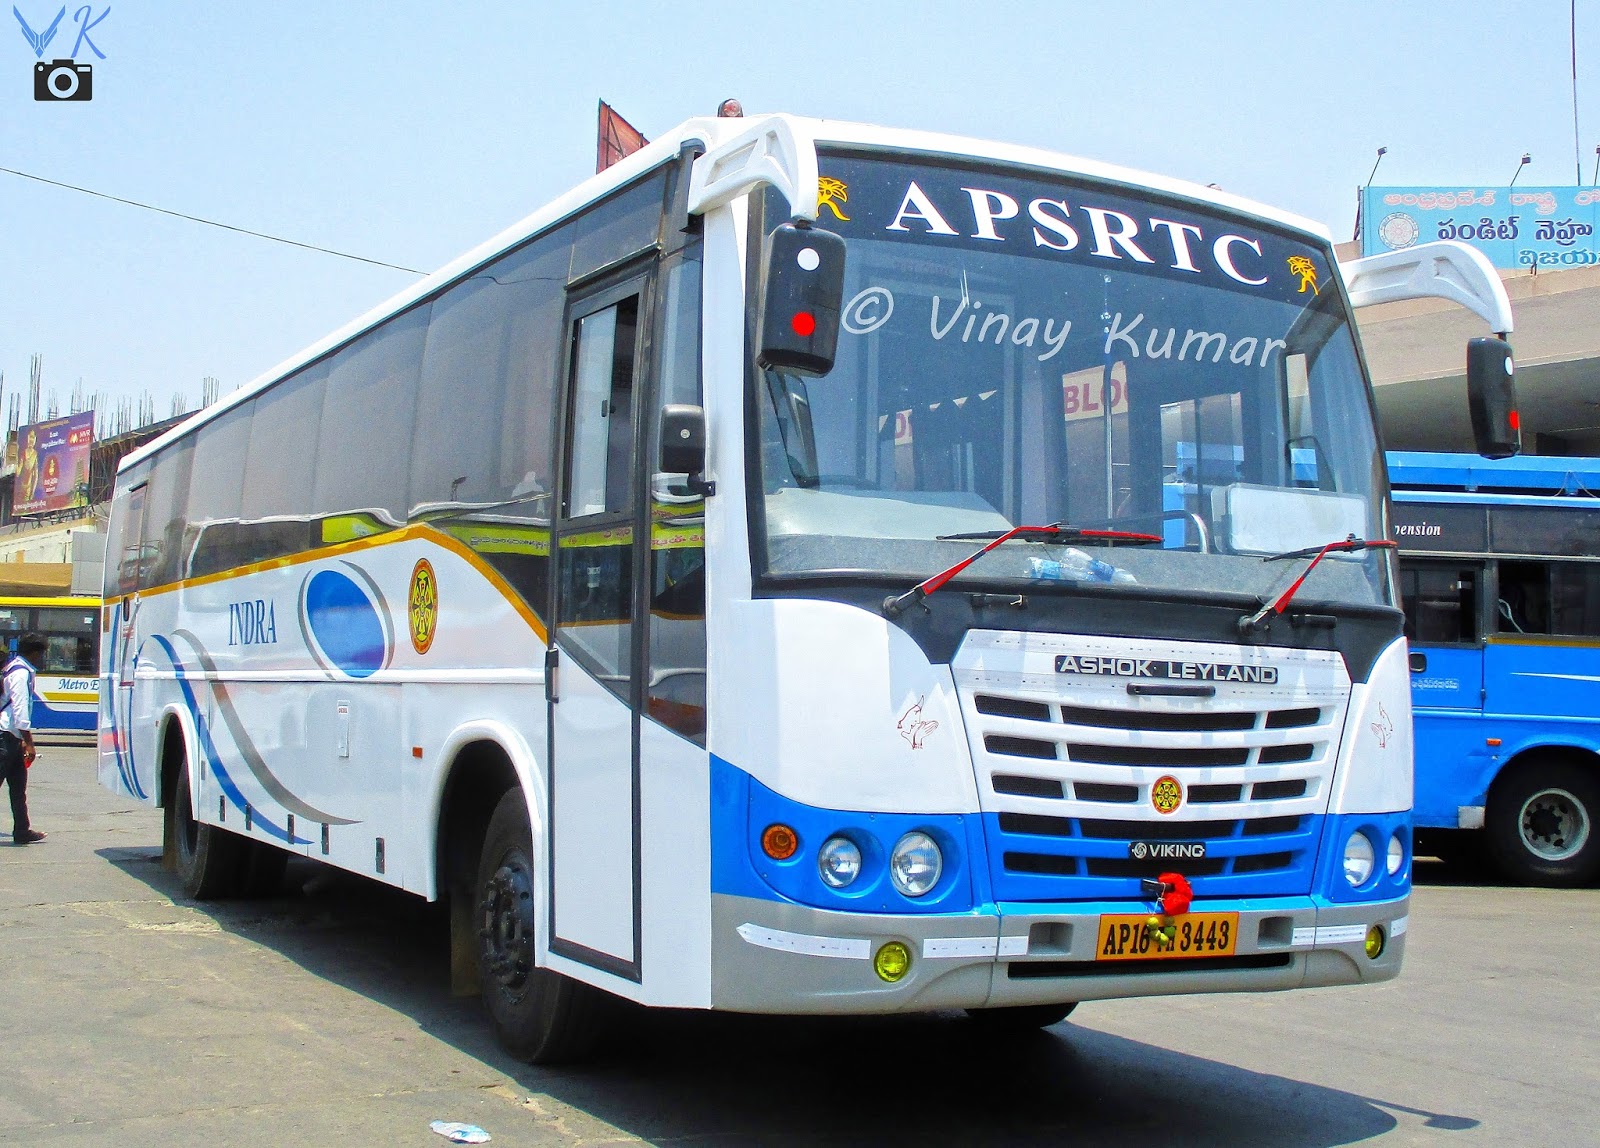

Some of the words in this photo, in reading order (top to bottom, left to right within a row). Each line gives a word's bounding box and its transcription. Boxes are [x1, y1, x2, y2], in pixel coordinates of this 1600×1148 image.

[885, 180, 1268, 286] APSRTC
[1437, 216, 1520, 241] పండిట్
[1519, 249, 1600, 265] విజయ
[1063, 378, 1128, 414] BLO
[228, 598, 278, 646] INDRA
[1060, 656, 1153, 678] ASHOK
[1167, 662, 1278, 684] LEYLAND
[58, 678, 89, 691] Metro
[1149, 844, 1205, 858] VIKING
[1180, 920, 1230, 952] 3443
